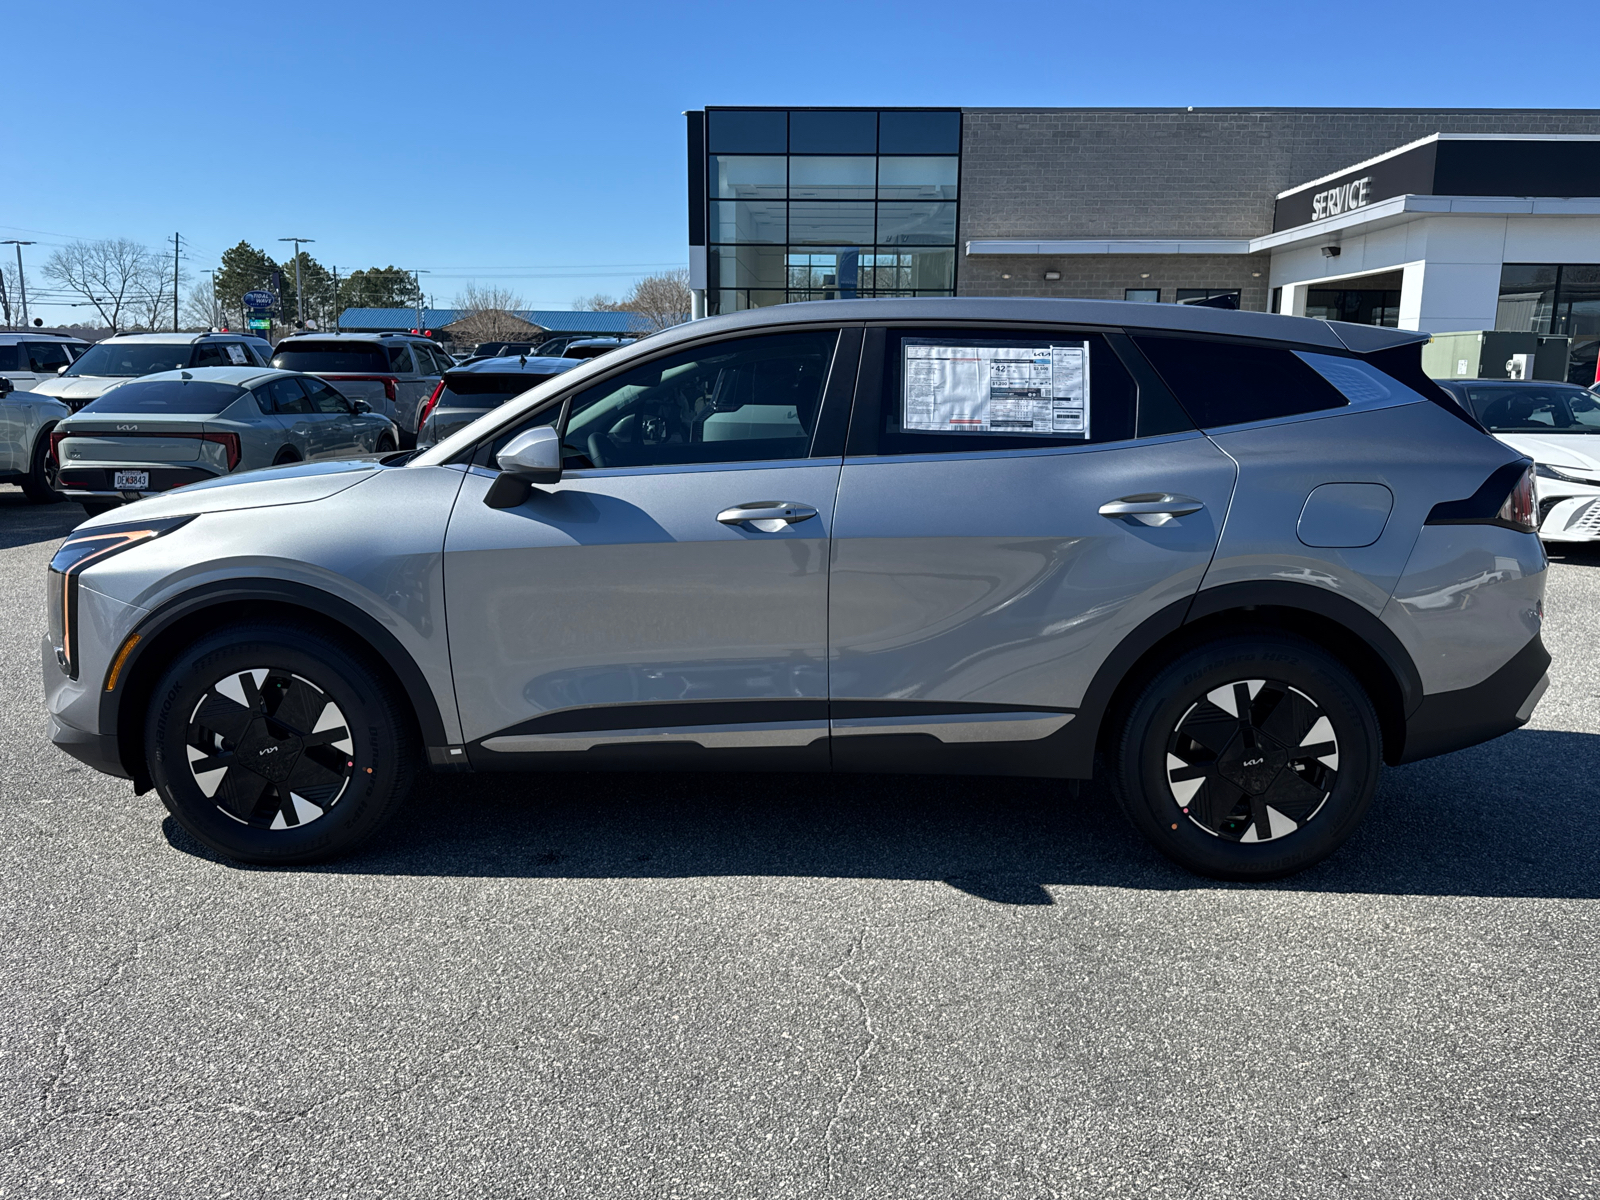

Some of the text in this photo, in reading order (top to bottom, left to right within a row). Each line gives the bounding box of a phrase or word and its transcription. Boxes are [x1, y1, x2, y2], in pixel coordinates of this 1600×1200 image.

[1311, 176, 1370, 221] SERVICE
[259, 745, 279, 757] KIA
[1242, 757, 1264, 767] KIA
